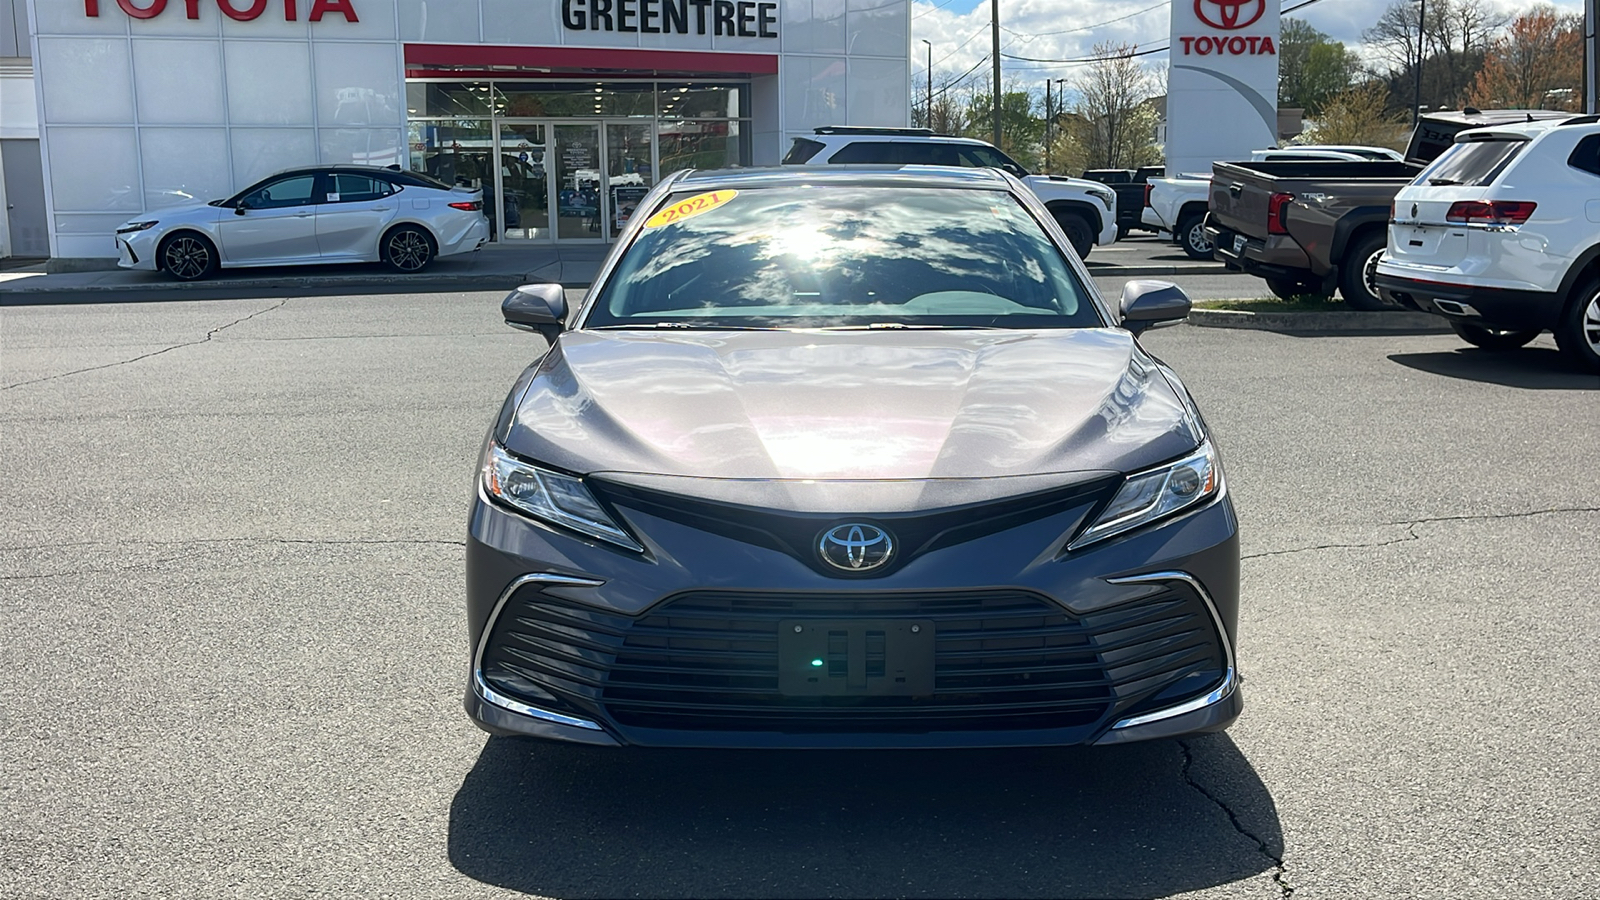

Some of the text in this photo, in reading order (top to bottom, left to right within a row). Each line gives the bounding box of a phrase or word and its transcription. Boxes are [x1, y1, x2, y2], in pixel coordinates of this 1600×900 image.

[561, 0, 778, 38] GREENTREE
[1179, 36, 1276, 55] TOYOTA
[662, 193, 723, 223] 2021
[1301, 192, 1326, 200] TRD
